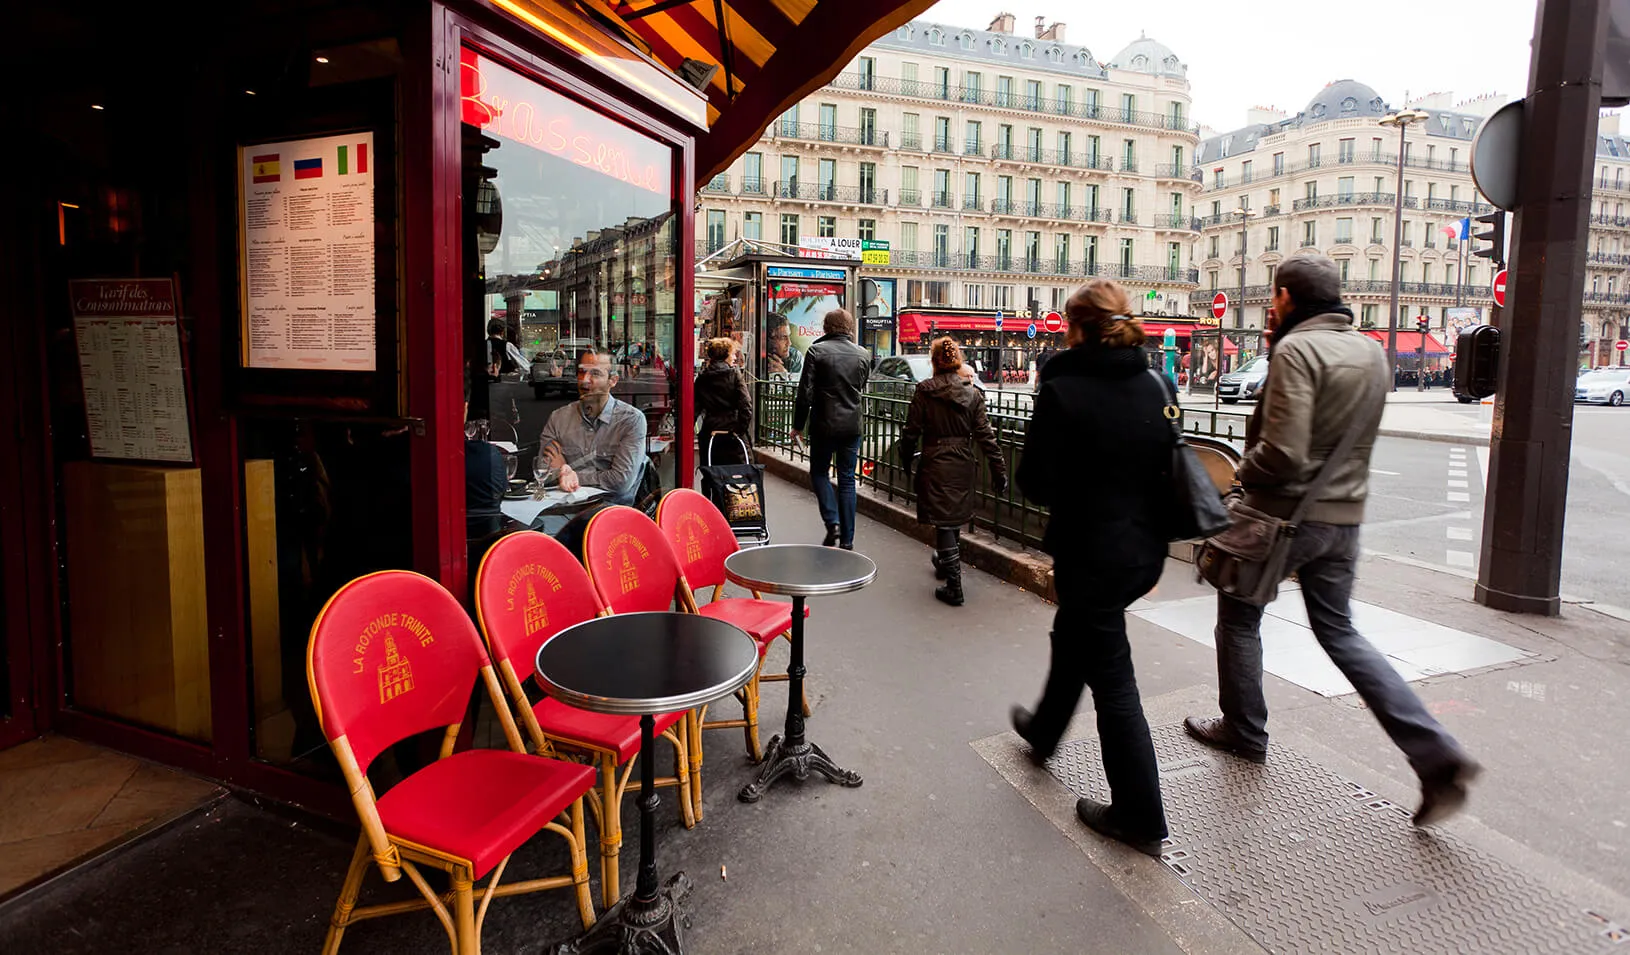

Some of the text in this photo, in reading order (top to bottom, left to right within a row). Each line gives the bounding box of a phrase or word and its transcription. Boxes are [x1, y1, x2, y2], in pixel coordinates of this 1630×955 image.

[837, 239, 861, 248] LOUER
[815, 270, 841, 279] Parisien
[99, 284, 149, 301] Tarif des
[76, 297, 172, 312] Consommations
[507, 598, 514, 611] LA
[353, 612, 435, 674] LA ROTONDE TRINITE
